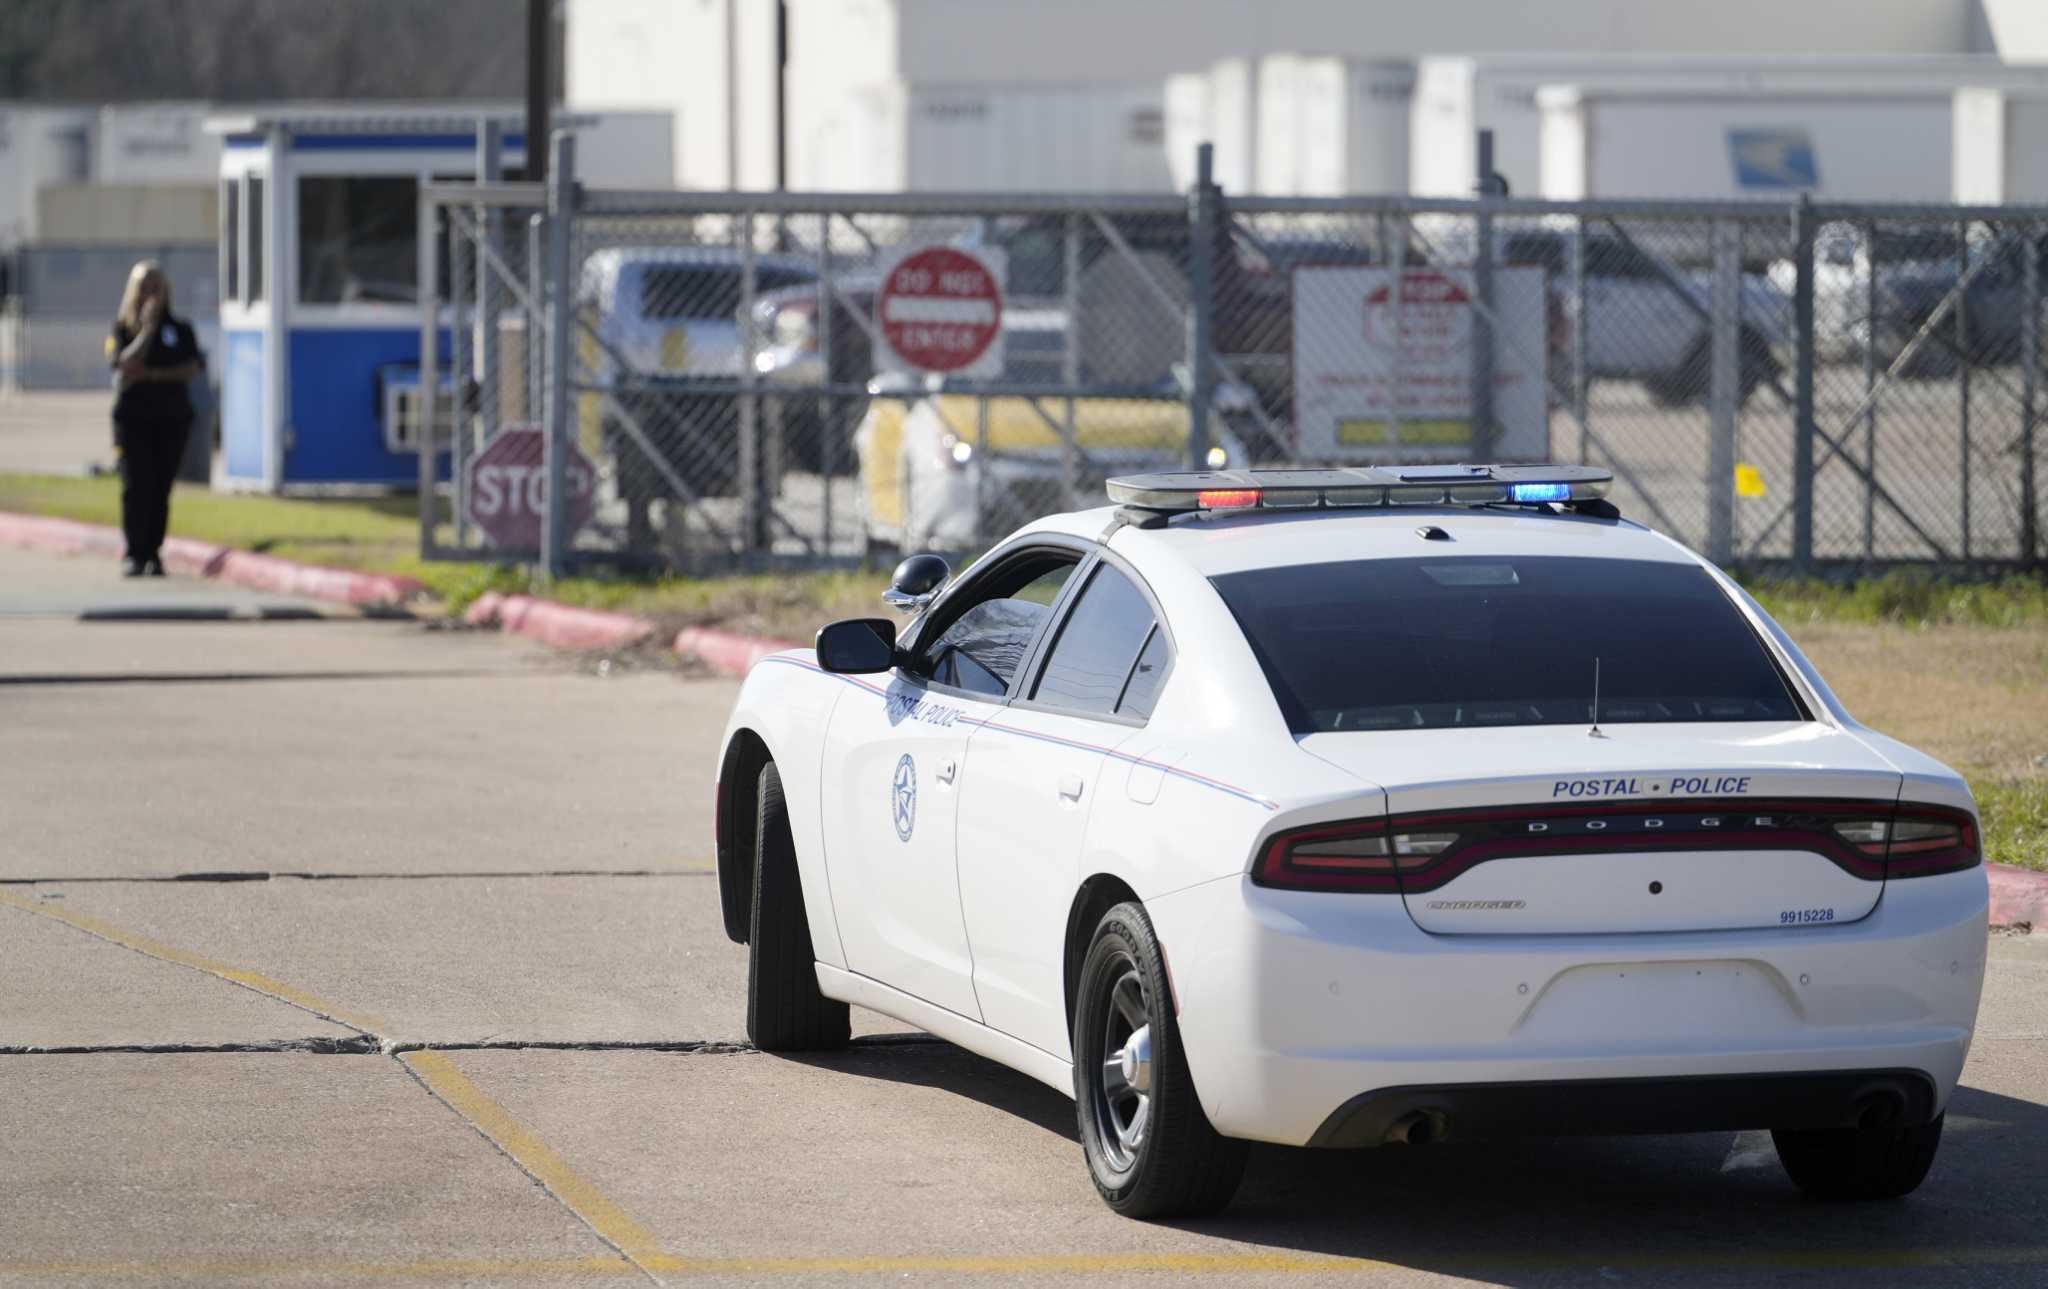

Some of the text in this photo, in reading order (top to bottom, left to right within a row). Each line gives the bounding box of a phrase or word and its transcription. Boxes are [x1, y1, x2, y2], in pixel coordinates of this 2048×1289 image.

[897, 269, 985, 294] DO NOT
[903, 329, 977, 351] ENTER
[1553, 777, 1751, 797] POSTAL POLICE
[1528, 816, 1773, 833] DODGE
[1780, 908, 1834, 923] 9915228
